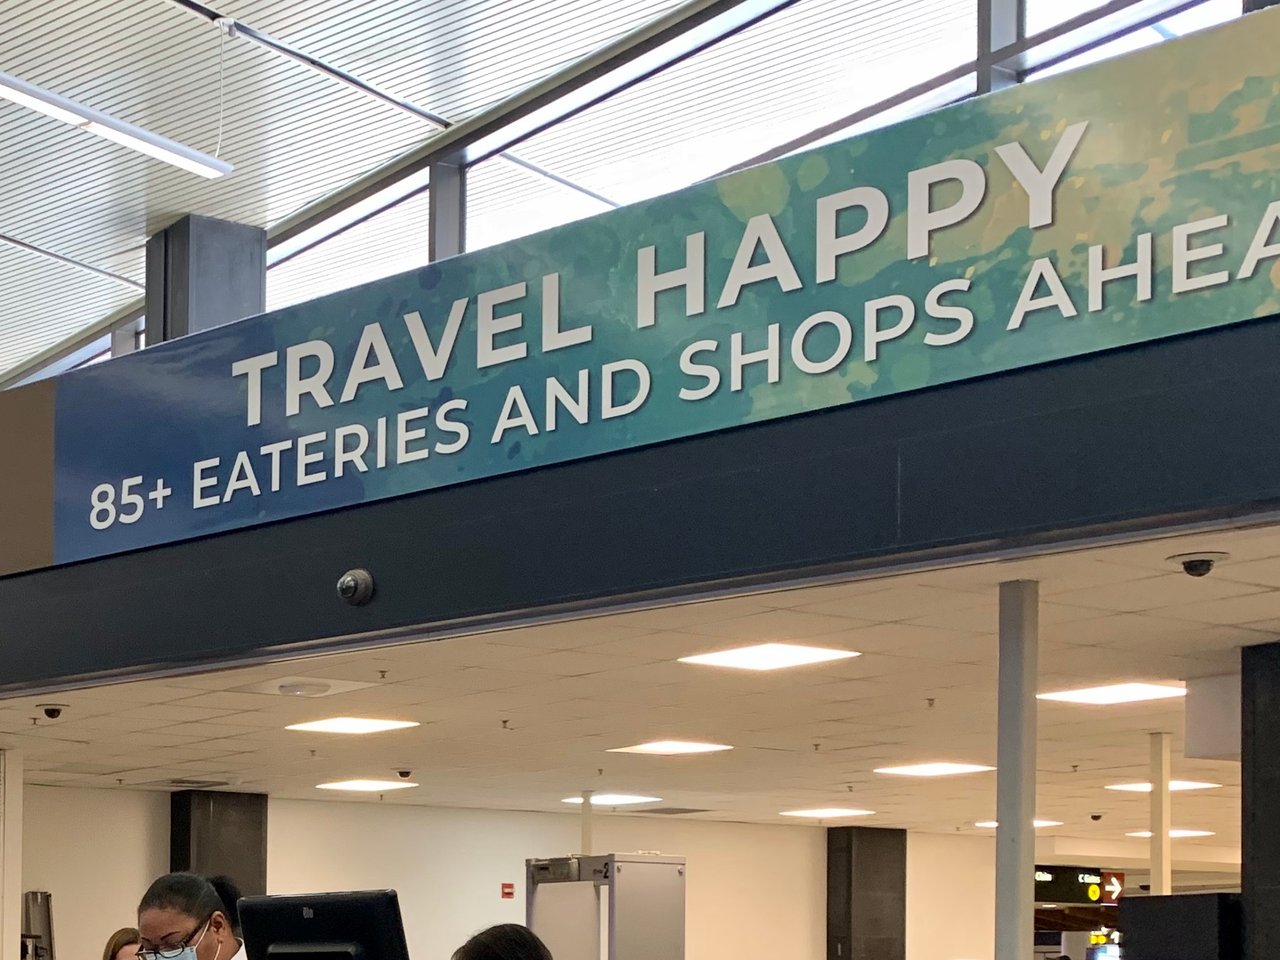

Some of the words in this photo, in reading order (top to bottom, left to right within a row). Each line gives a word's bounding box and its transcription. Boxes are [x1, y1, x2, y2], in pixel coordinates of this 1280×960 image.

[88, 475, 172, 530] 85+
[192, 398, 471, 509] EATERIES
[490, 358, 652, 444] AND
[678, 278, 975, 401] SHOPS
[1006, 200, 1280, 331] AHEA
[231, 272, 593, 427] TRAVEL
[637, 120, 1090, 329] HAPPY
